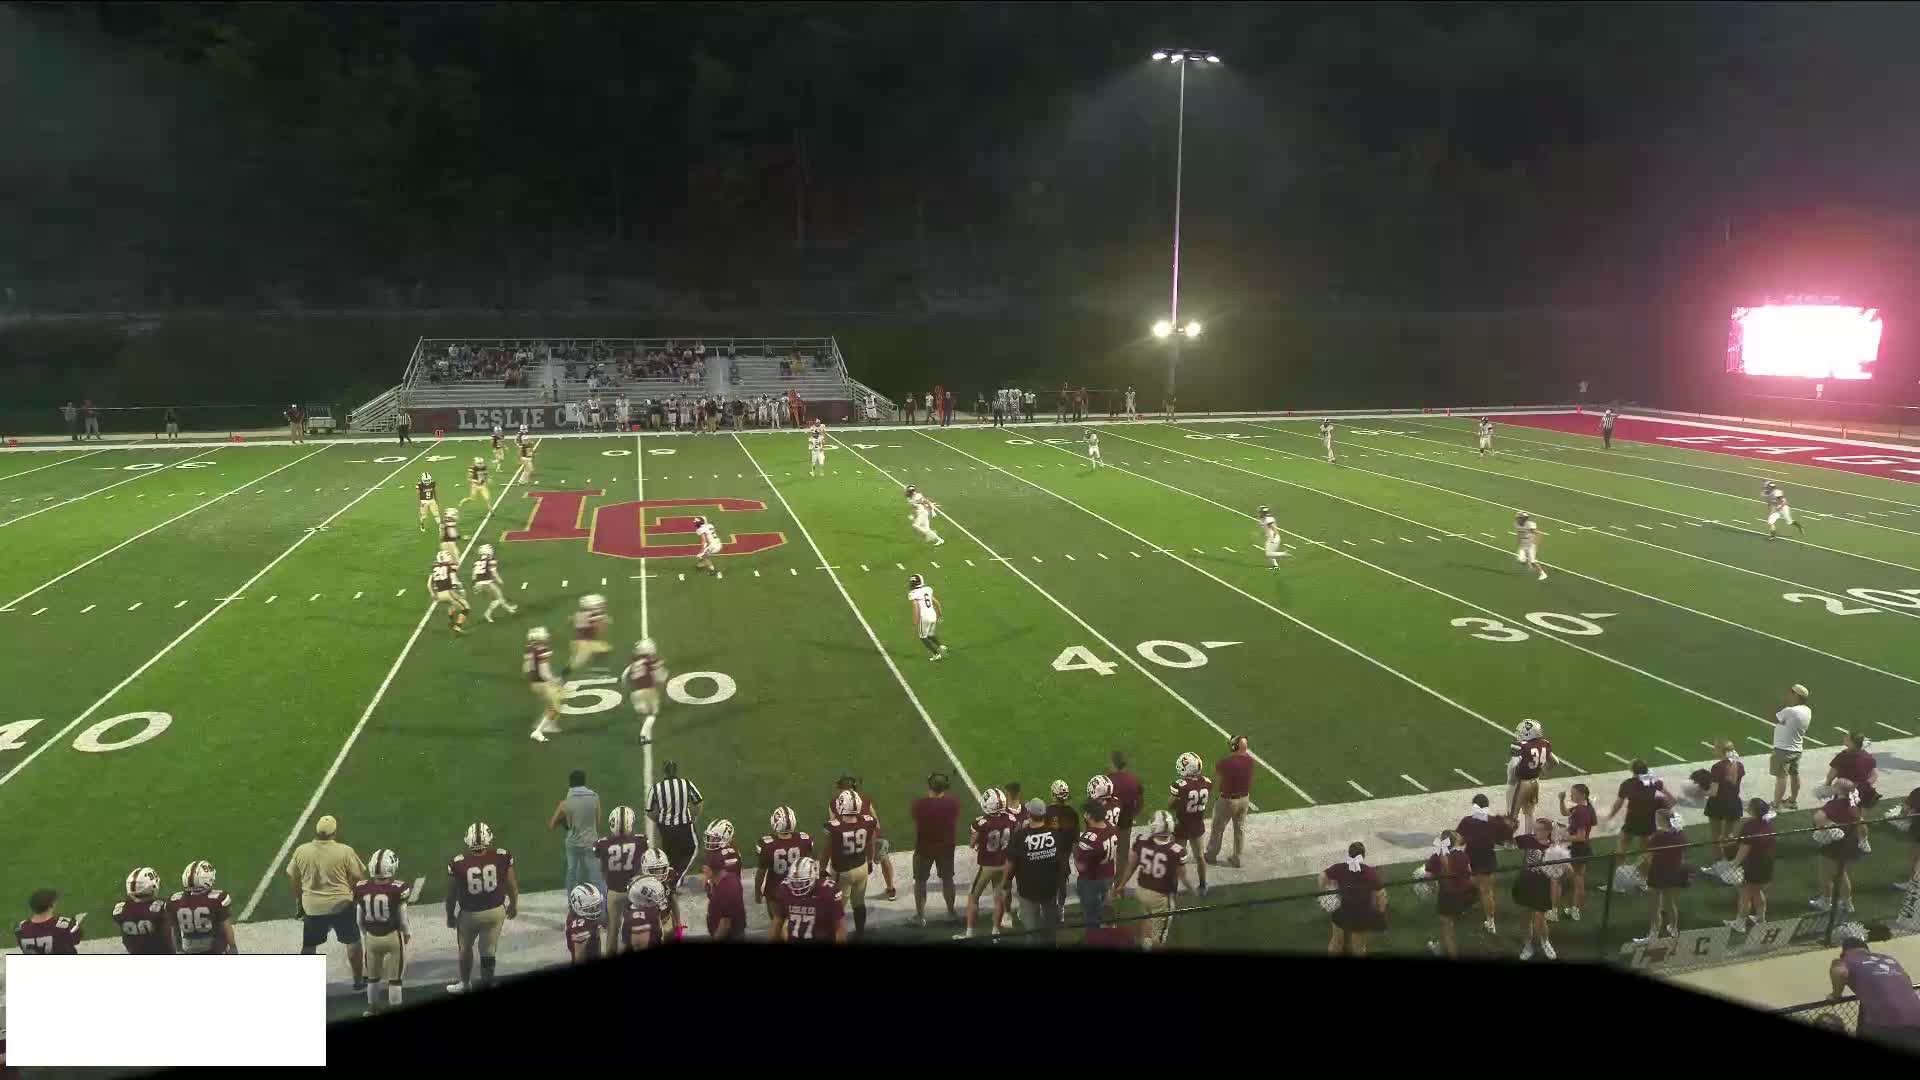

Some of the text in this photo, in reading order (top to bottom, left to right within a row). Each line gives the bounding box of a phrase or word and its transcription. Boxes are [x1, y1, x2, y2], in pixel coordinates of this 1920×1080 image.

[457, 407, 545, 430] LESLIE
[924, 592, 931, 609] 6
[1450, 611, 1604, 643] 30
[1051, 639, 1209, 677] 40
[557, 671, 737, 715] 50
[1186, 788, 1209, 813] 23
[841, 828, 868, 854] 59
[1023, 831, 1056, 851] 1975
[607, 842, 636, 872] 27
[1140, 847, 1168, 879] 56
[466, 863, 498, 895] 68
[176, 906, 214, 933] 86
[362, 893, 391, 922] 10
[788, 915, 817, 940] 77
